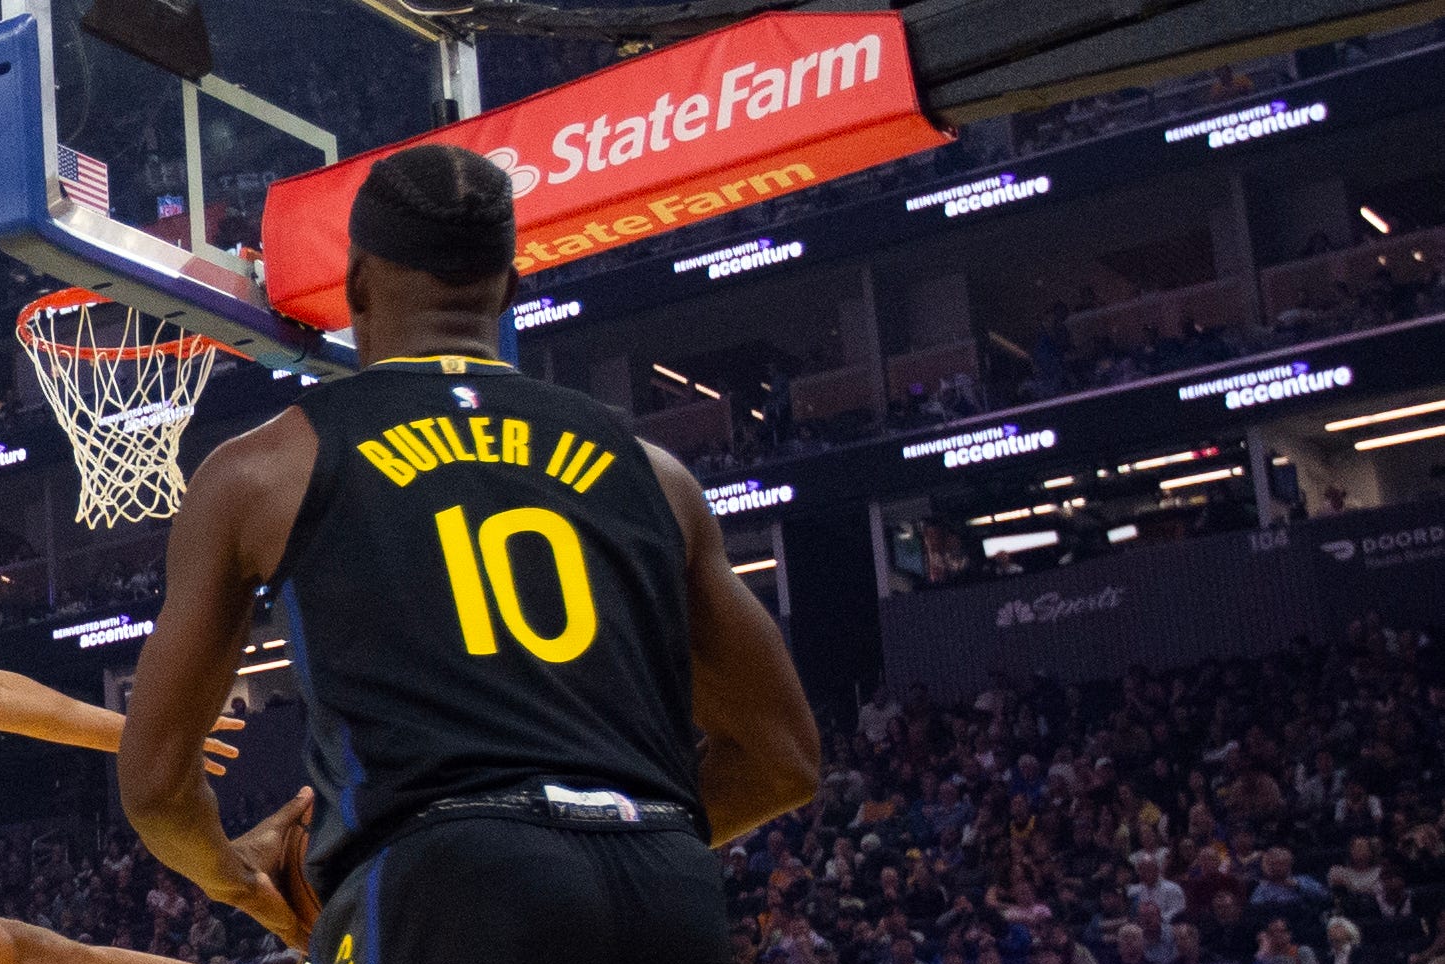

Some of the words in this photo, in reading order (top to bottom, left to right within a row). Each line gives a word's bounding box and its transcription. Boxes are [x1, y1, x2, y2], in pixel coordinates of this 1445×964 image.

[548, 92, 709, 184] State
[716, 34, 880, 131] Farm
[1165, 113, 1238, 143] REINVENTED
[1238, 104, 1270, 122] WITH
[1209, 103, 1326, 148] accenture
[649, 163, 816, 225] Farm
[906, 183, 971, 212] REINVENTED
[971, 176, 1001, 194] WITH
[944, 176, 1050, 218] accenture
[674, 248, 732, 273] REINVENTED
[732, 241, 758, 256] WITH
[708, 241, 802, 279] accenture
[514, 301, 581, 331] centure
[1179, 371, 1257, 400] REINVENTED
[1257, 365, 1292, 383] WITH
[1225, 366, 1352, 409] accenture
[357, 417, 530, 488] BUTLER
[545, 431, 615, 494] III
[903, 433, 972, 459] REINVENTED
[972, 426, 1003, 444] WITH
[943, 429, 1054, 468] accenture
[708, 485, 793, 516] centure
[718, 481, 747, 497] WITH
[435, 505, 597, 663] 10
[53, 622, 100, 639] REINVENTED
[100, 617, 120, 630] WITH
[79, 620, 153, 648] accenture
